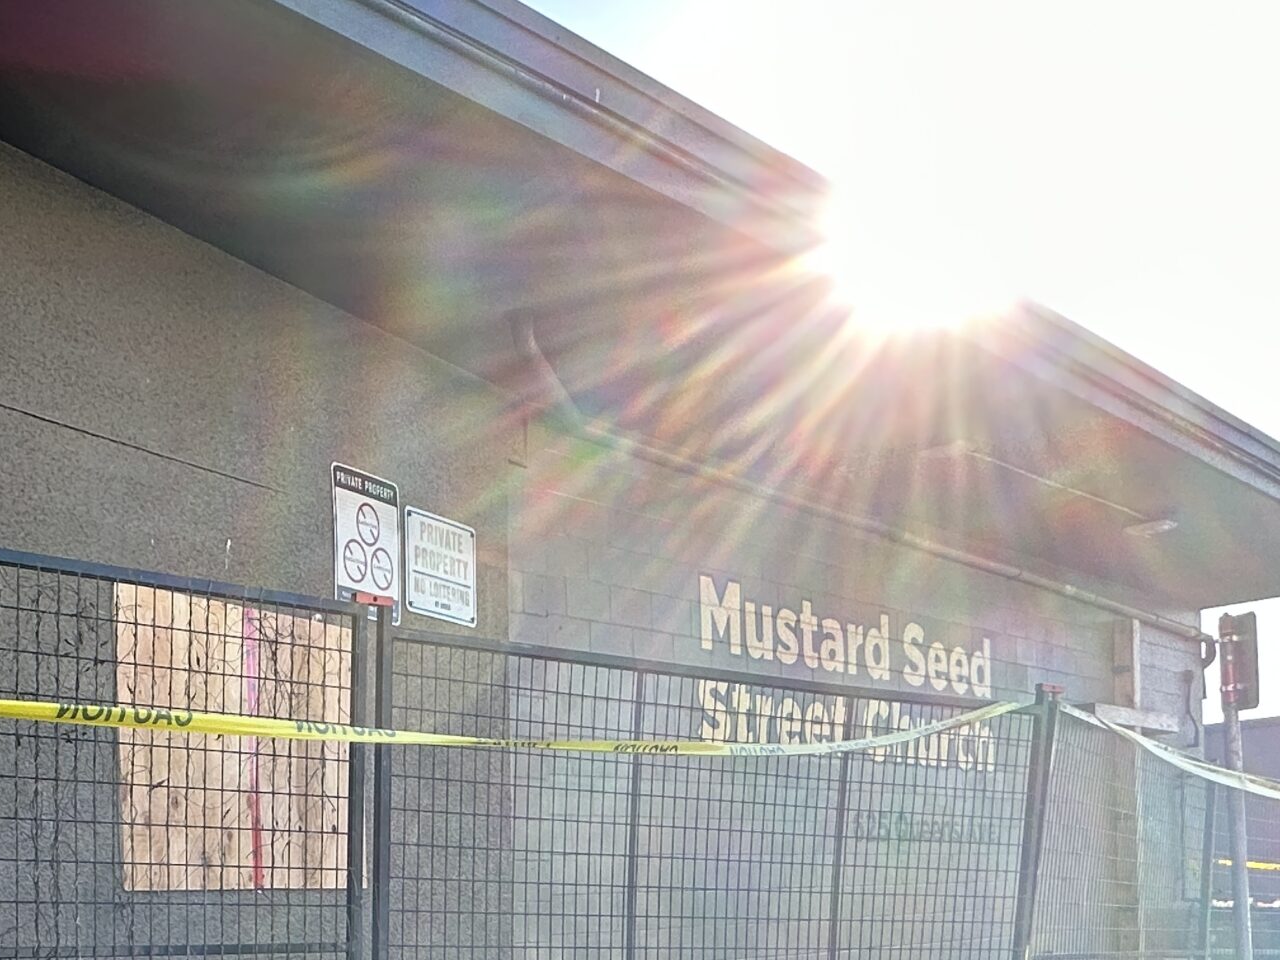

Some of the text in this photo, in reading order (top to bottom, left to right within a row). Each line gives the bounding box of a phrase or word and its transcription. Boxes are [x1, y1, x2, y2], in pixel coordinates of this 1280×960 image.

[336, 471, 363, 490] PRIVATE
[419, 520, 464, 554] PRIVATE
[414, 544, 469, 581] PROPERTY
[413, 575, 427, 594] NO
[429, 578, 471, 607] LOITERING
[697, 574, 993, 699] Mustard Seed
[697, 680, 996, 773] Street Church
